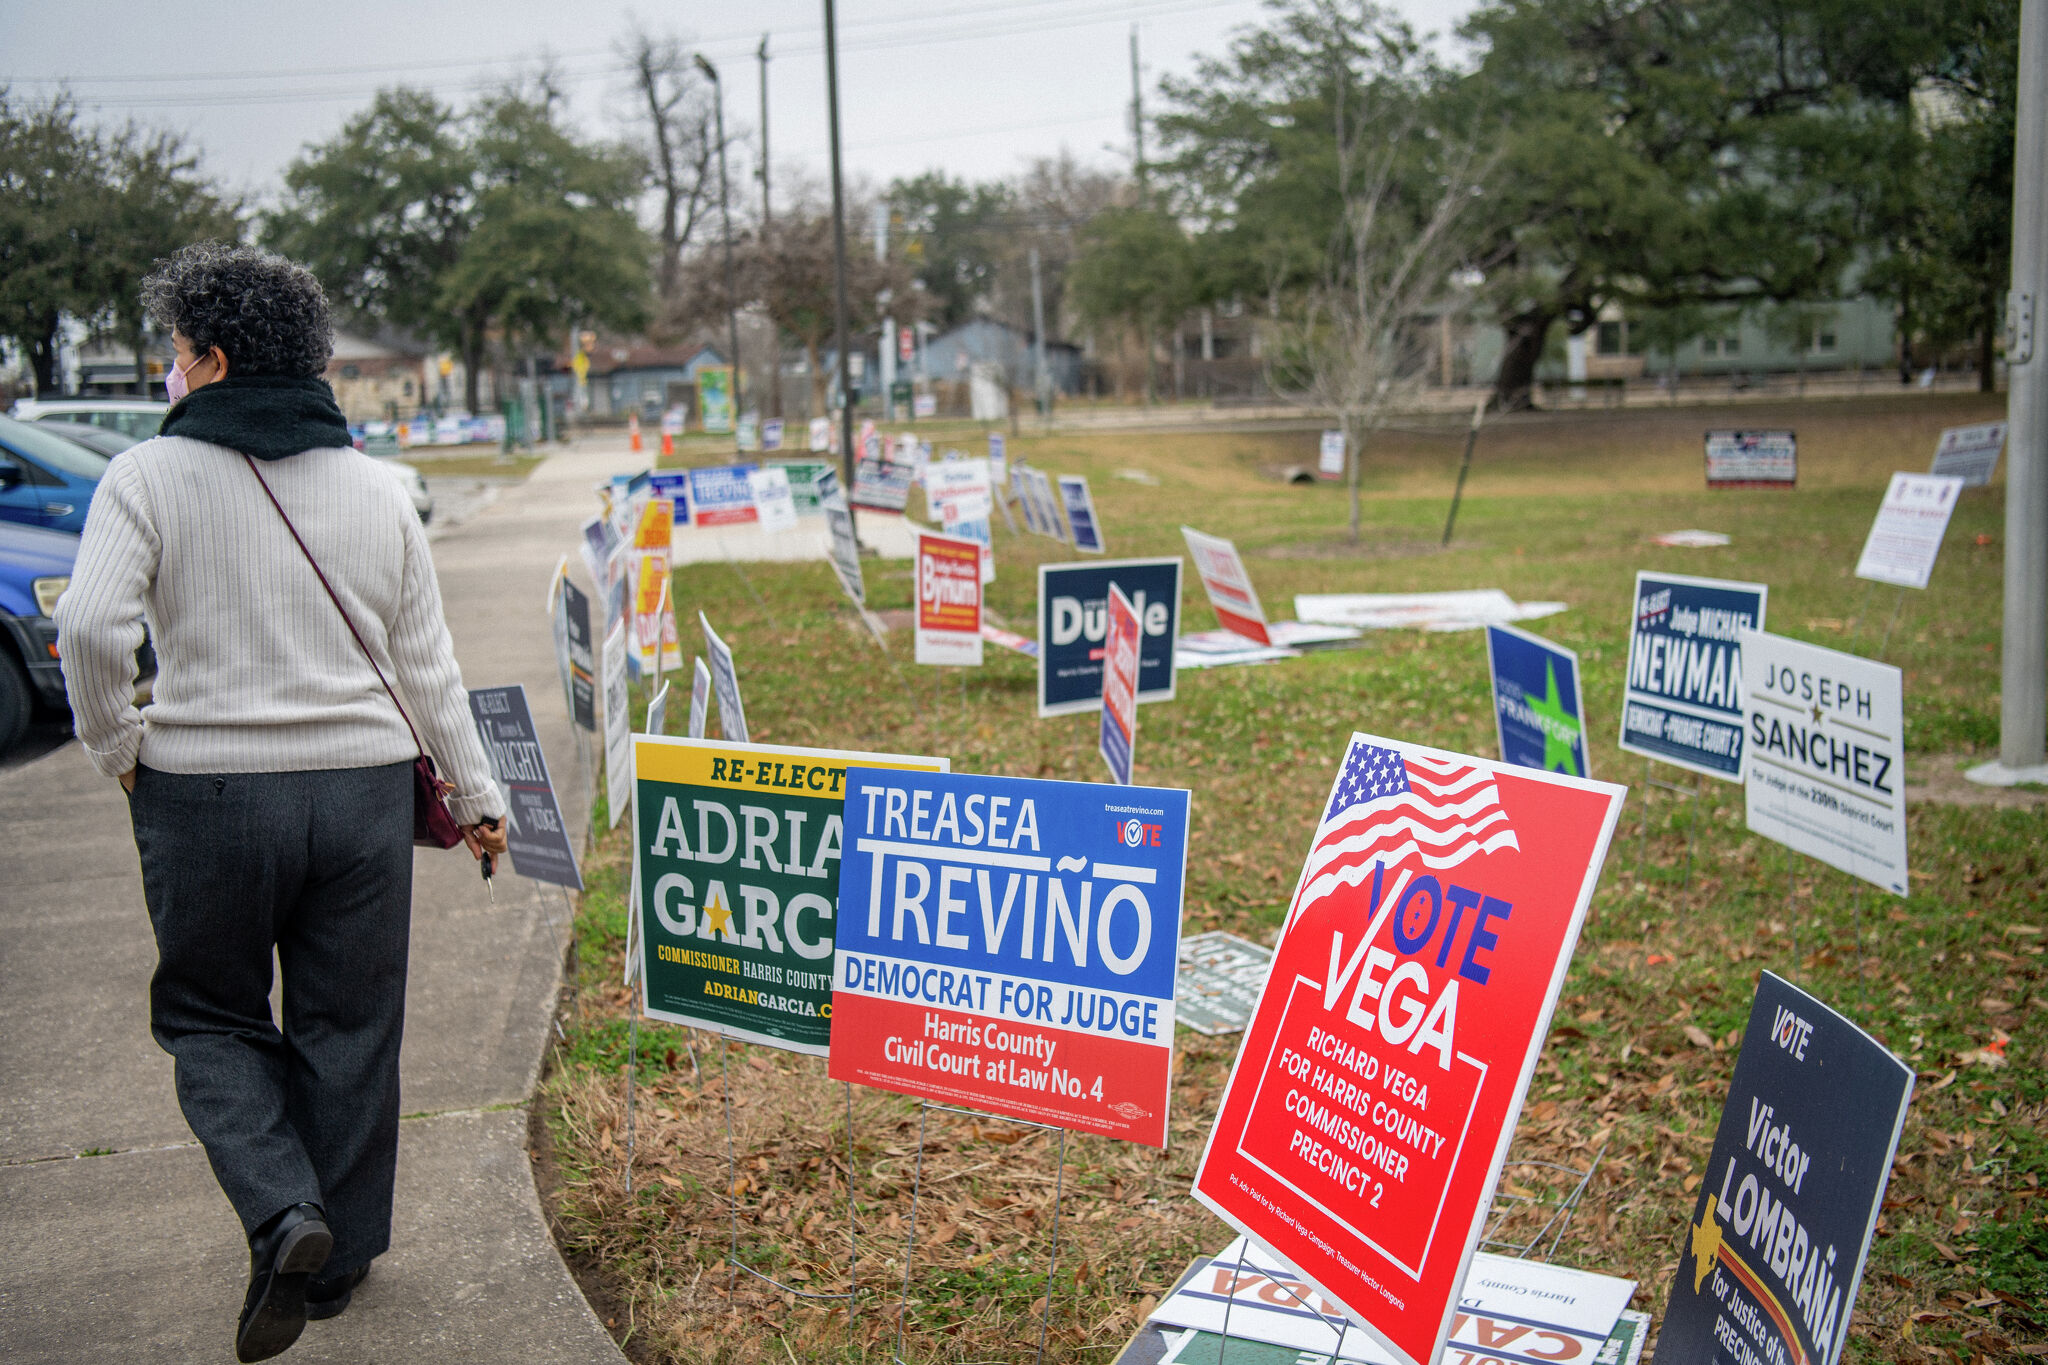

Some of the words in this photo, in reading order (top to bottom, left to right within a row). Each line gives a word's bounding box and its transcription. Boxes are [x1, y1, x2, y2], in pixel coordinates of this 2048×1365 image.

[922, 554, 978, 615] Bynum
[1052, 591, 1168, 646] Dule
[1669, 604, 1699, 637] Judge
[1631, 631, 1744, 711] NEWMAN
[1765, 664, 1872, 720] JOSEPH
[1703, 722, 1731, 755] COURT
[1730, 729, 1741, 758] 2
[1751, 712, 1893, 796] SANCHEZ
[711, 757, 846, 793] RE-ELECT
[651, 796, 844, 880] ADRIA
[861, 785, 1041, 851] TREASEA
[1105, 803, 1163, 816] treaseatrevino.com
[1117, 819, 1162, 847] VOTE
[1870, 814, 1894, 835] Court
[653, 872, 838, 960] GARC
[857, 838, 1157, 976] TREVIÑO
[1368, 860, 1513, 986] VOTE
[658, 945, 740, 976] COMMISSIONER
[743, 960, 783, 984] HARRIS
[786, 969, 835, 992] COUNTY
[704, 980, 833, 1018] ADRIANGARCIA.C
[845, 956, 992, 1011] DEMOCRAT
[1000, 980, 1053, 1022] FOR
[1061, 991, 1158, 1040] JUDGE
[1323, 869, 1461, 1072] VEGA
[924, 1012, 982, 1038] Harris
[983, 1023, 1057, 1067] County
[1770, 1005, 1814, 1062] VOTE
[884, 1036, 923, 1068] Civil
[926, 1043, 980, 1079] Court
[986, 1056, 1007, 1083] at
[1009, 1059, 1048, 1092] Law
[1051, 1066, 1087, 1100] No.
[1090, 1075, 1104, 1102] 4
[1306, 1025, 1379, 1081] RICHARD
[1383, 1064, 1428, 1111] VEGA
[1278, 1047, 1308, 1080] FOR
[1311, 1070, 1371, 1117] HARRIS
[1373, 1101, 1447, 1160] COUNTY
[1285, 1089, 1409, 1183] COMMISSIONER
[1290, 1129, 1371, 1198] PRECINCT
[1370, 1182, 1384, 1209] 2
[1745, 1096, 1810, 1195] Victor
[1229, 1173, 1239, 1187] Pol.
[1239, 1180, 1251, 1195] Adv.
[1250, 1187, 1261, 1203] Paid
[1260, 1194, 1269, 1209] for
[1268, 1201, 1275, 1215] by
[1275, 1205, 1295, 1227] Richard
[1295, 1220, 1308, 1237] Vega
[1336, 1250, 1361, 1275] Treasurer
[1361, 1267, 1381, 1291] Hector
[1379, 1281, 1405, 1310] Longoria
[1716, 1156, 1841, 1352] LOMBRAÑA
[1477, 1278, 1527, 1297] County
[1530, 1288, 1576, 1306] Harris
[1711, 1267, 1729, 1302] for
[1727, 1287, 1767, 1348] Justice
[1766, 1336, 1779, 1364] of
